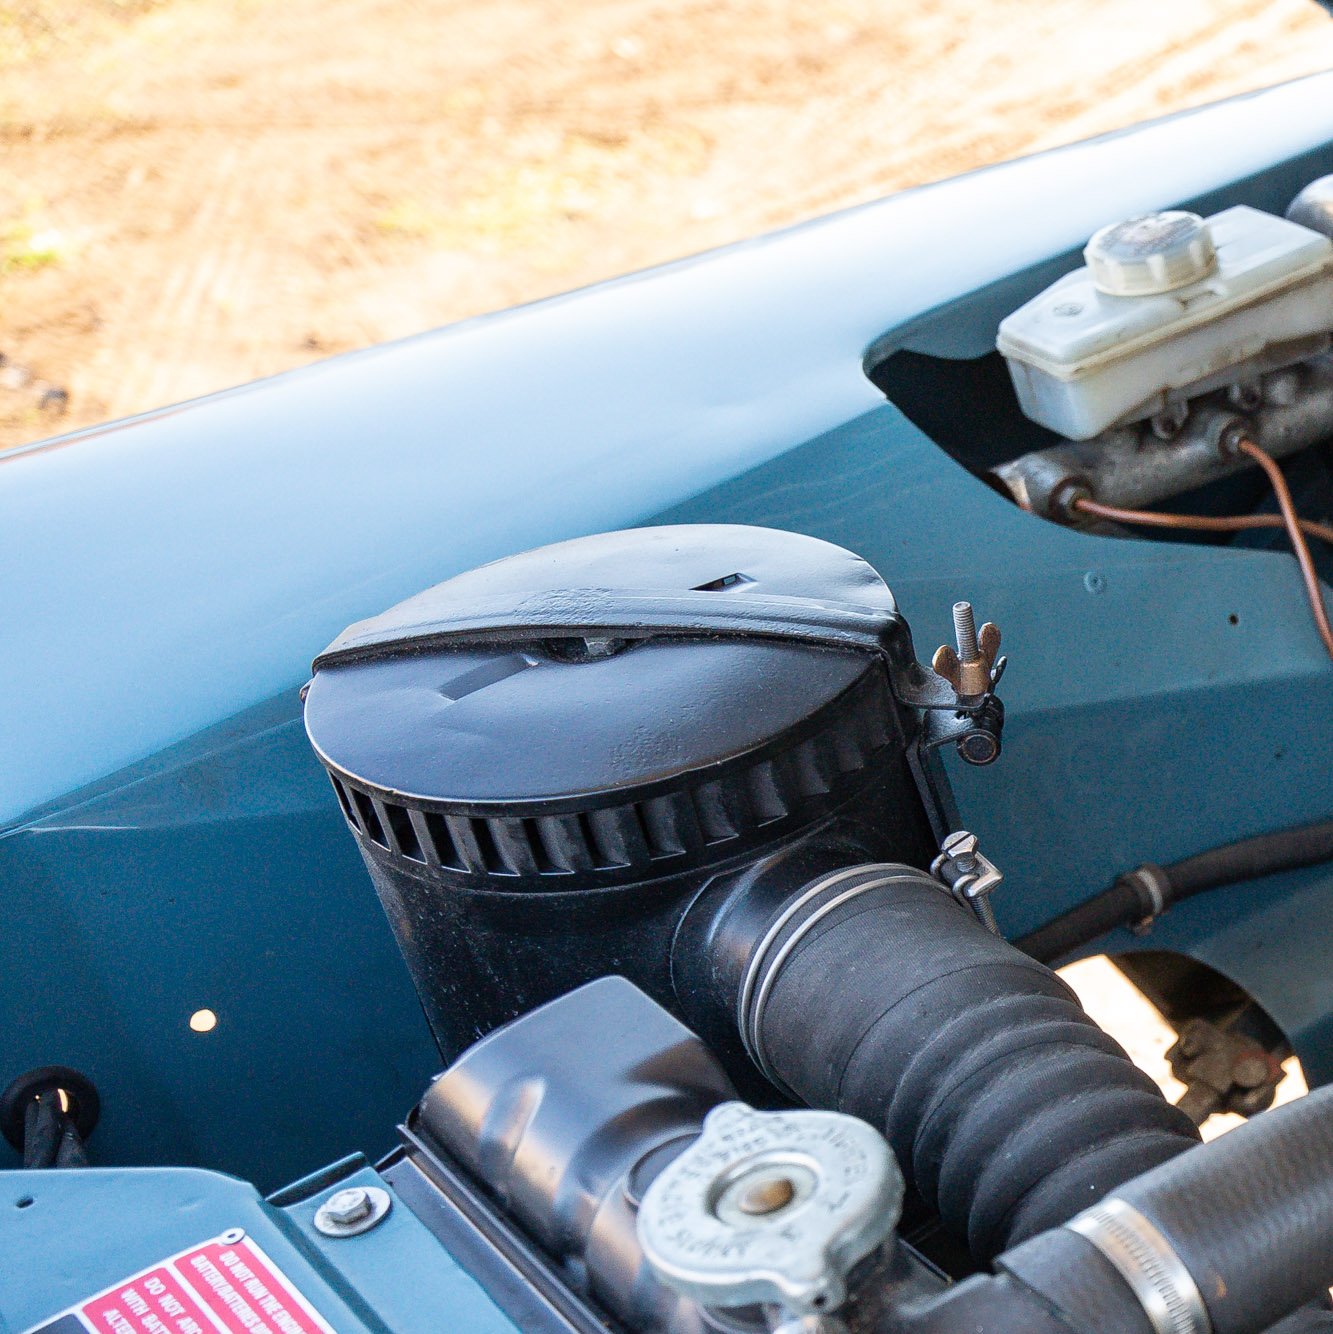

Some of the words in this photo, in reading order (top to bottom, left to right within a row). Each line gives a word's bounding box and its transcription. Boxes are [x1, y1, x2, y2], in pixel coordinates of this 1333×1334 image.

[121, 1287, 151, 1317] WITH
[143, 1277, 167, 1296] DO
[158, 1293, 186, 1317] NOT
[229, 1261, 256, 1282] NOT
[259, 1294, 284, 1315] THE
